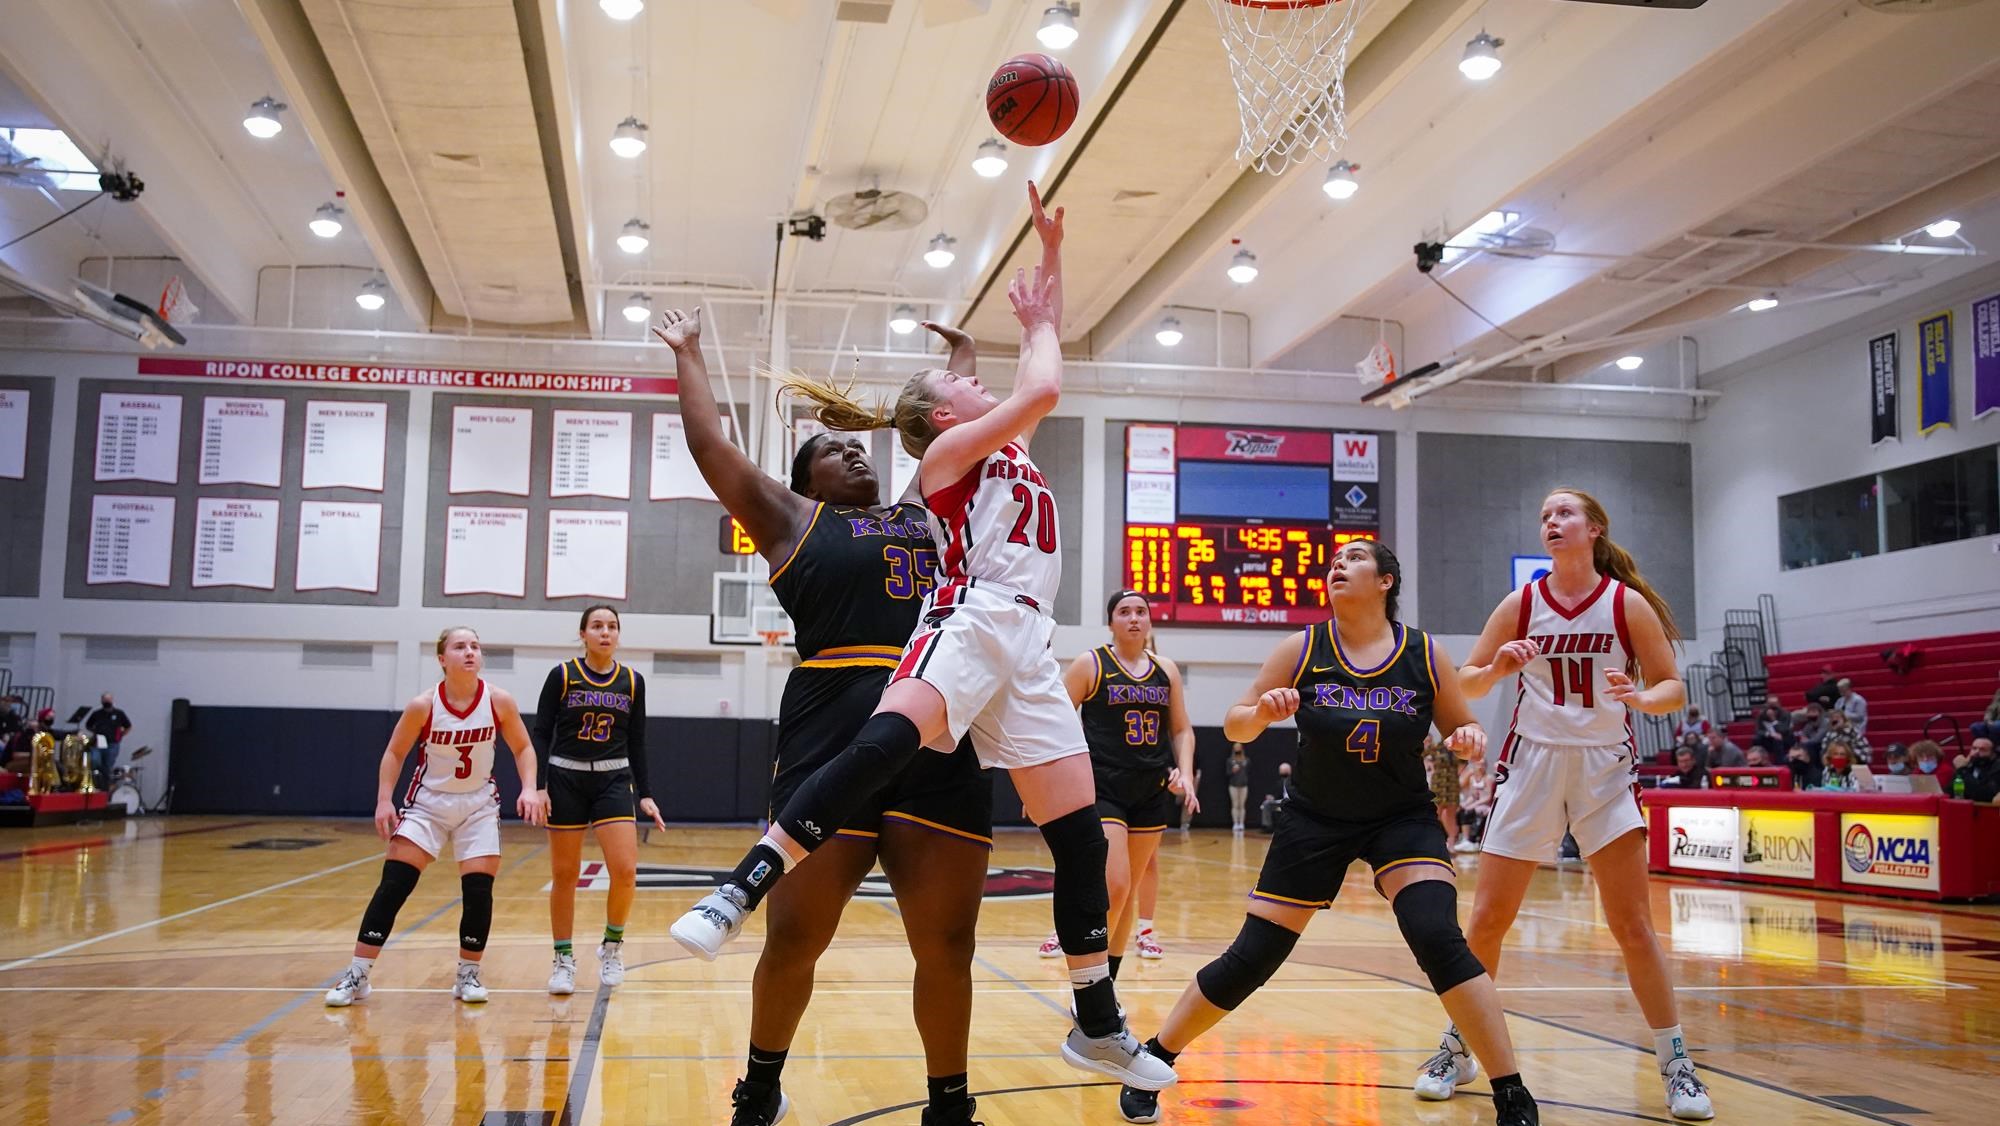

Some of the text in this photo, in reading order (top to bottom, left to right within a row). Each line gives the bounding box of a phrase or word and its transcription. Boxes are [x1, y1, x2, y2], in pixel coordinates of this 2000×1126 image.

[206, 362, 632, 392] RIPON COLLEGE CONFERENCE CHAMPIONSHIPS
[120, 401, 161, 410] BASEBALL
[218, 409, 269, 417] BASKETBALL
[1344, 439, 1368, 457] W
[112, 503, 154, 511] FOOTBALL
[212, 510, 263, 518] BASKETBALL
[321, 510, 360, 518] SOFTBALL
[1007, 482, 1057, 554] 20
[1188, 539, 1215, 562] 26
[1239, 528, 1282, 551] 4:35
[1298, 542, 1324, 565] 21
[883, 544, 940, 600] 35
[1243, 562, 1267, 573] period
[1271, 558, 1283, 576] 2
[1192, 586, 1204, 605] 5
[1212, 588, 1224, 604] 4
[1285, 590, 1296, 606] 4
[1221, 608, 1288, 623] WE ONE
[1546, 657, 1594, 708] 14
[567, 690, 631, 714] KNOX
[1314, 683, 1417, 715] KNOX
[430, 726, 494, 746] RED HAWKS
[577, 711, 614, 742] 13
[1124, 710, 1160, 745] 33
[1346, 718, 1380, 763] 4
[454, 745, 474, 779] 3
[1673, 827, 1698, 856] RED
[1698, 845, 1733, 859] HAWKS
[1763, 835, 1813, 863] RIPON
[1876, 836, 1930, 865] NCAA
[1873, 863, 1928, 878] VOLLEYBALL
